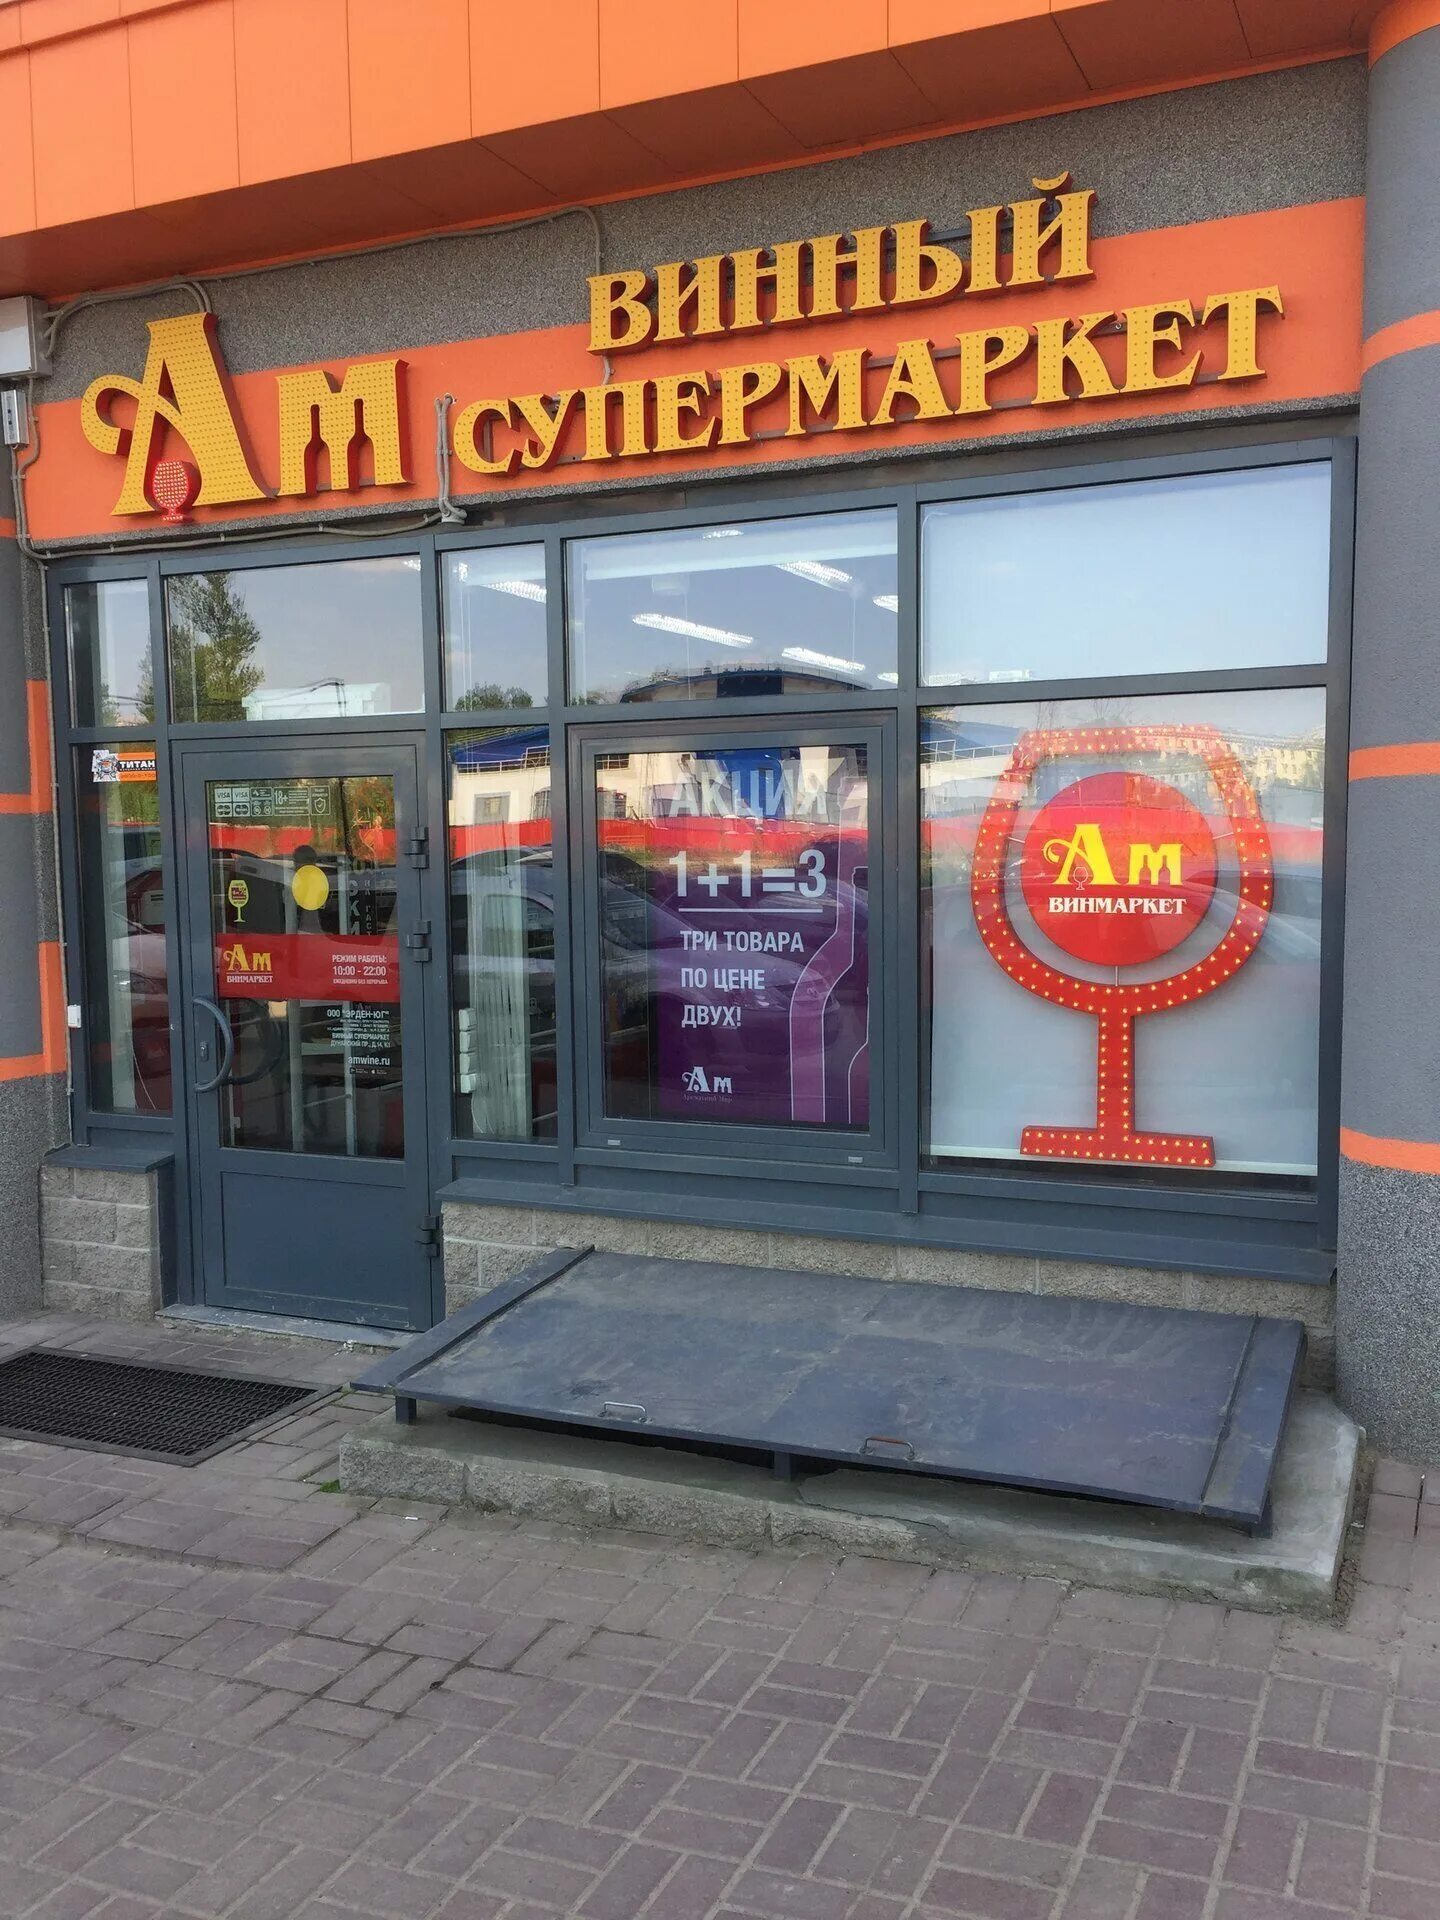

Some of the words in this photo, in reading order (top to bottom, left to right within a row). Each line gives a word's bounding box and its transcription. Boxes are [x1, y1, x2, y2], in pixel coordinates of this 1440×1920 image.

[586, 171, 1095, 356] ВИННЫЙ
[452, 285, 1285, 476] СУПЕРМАРКЕТ
[119, 760, 155, 769] ТИТАН
[273, 790, 289, 805] 18+
[668, 768, 829, 825] АКЦИЯ
[668, 849, 828, 898] 1+1=3
[1048, 897, 1186, 915] ВИНМАРКЕТ
[680, 930, 718, 951] ТРИ
[723, 931, 804, 953] ТОВАРА
[332, 954, 357, 963] РЕЖИМ
[357, 954, 387, 963] РАБОТЫ:
[226, 975, 274, 983] ВИНМАРКЕТ
[333, 965, 356, 976] 10:00
[363, 965, 387, 976] 22:00
[681, 967, 708, 989] ПО
[713, 968, 766, 992] ЦЕНЕ
[326, 1009, 341, 1018] ООО
[681, 1004, 741, 1029] ДВУХ!
[347, 1055, 391, 1066] amwine.ru
